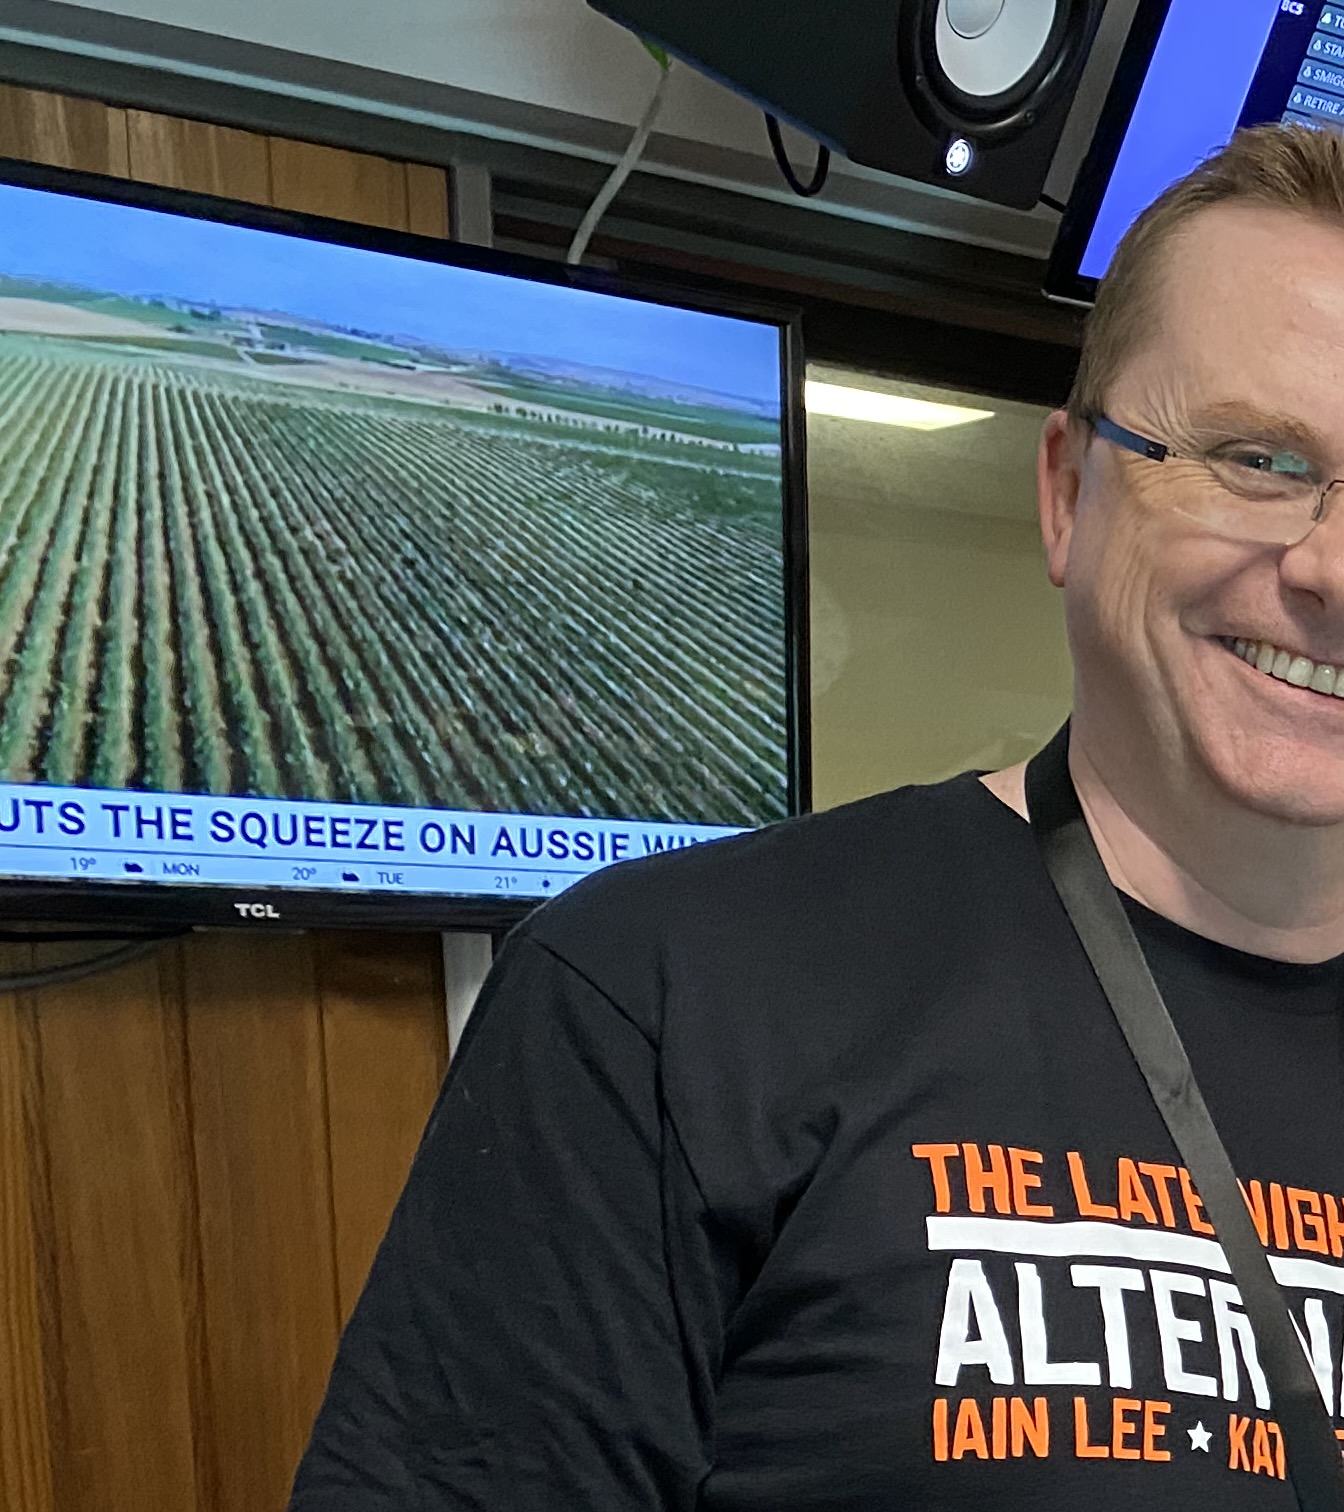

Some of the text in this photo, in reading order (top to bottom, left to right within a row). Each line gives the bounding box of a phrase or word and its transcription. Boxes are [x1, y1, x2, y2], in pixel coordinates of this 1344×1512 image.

[1304, 95, 1340, 114] RETIRE
[102, 803, 194, 842] THE
[210, 810, 406, 851] SQUEEZE
[420, 822, 476, 855] ON
[491, 826, 630, 862] AUSSIE
[163, 862, 200, 877] MON
[377, 871, 404, 885] TUE
[234, 903, 281, 918] TCL
[912, 1142, 1054, 1218] THE
[1067, 1151, 1216, 1235] LATE
[932, 1396, 1049, 1462] IAIN
[1074, 1396, 1172, 1462] LEE
